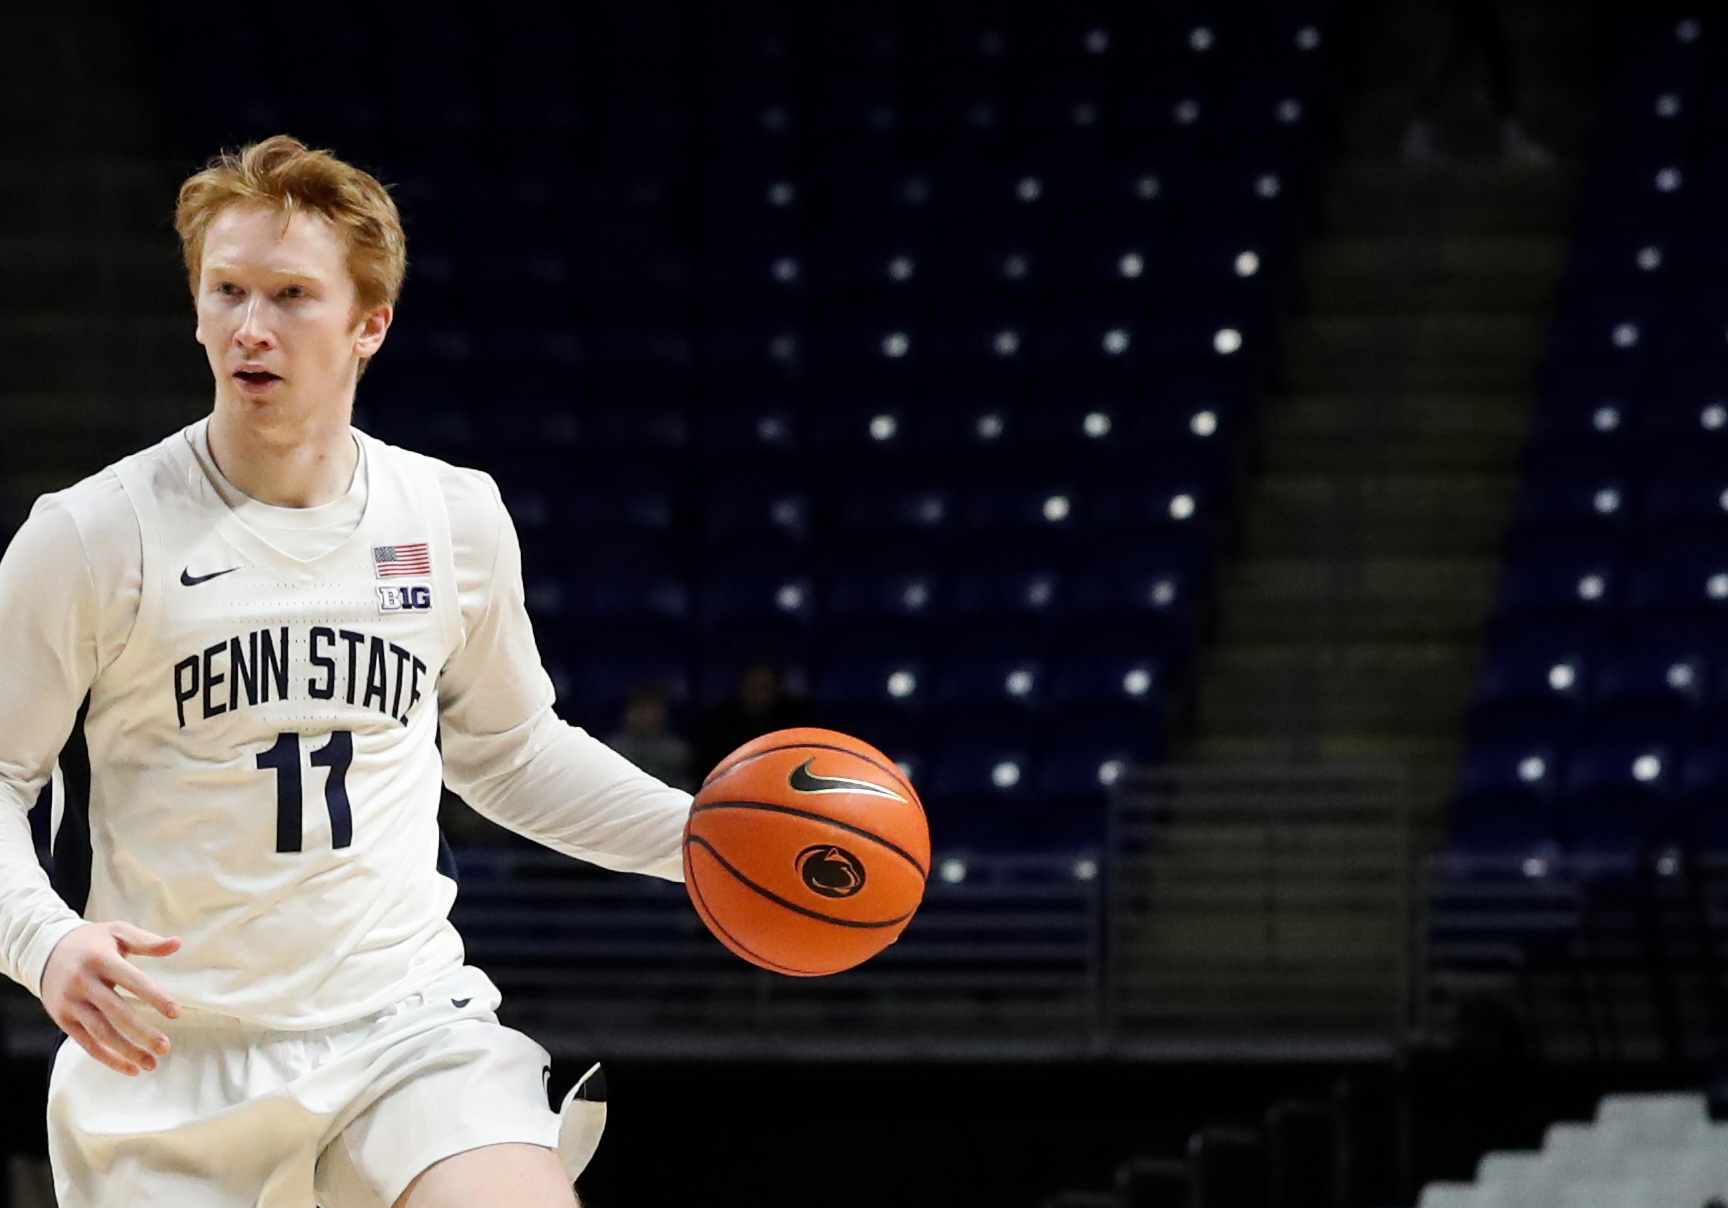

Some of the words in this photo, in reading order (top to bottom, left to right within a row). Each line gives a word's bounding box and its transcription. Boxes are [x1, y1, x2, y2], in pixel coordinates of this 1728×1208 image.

[174, 626, 289, 729] PENN
[308, 626, 427, 727] STATE
[256, 730, 354, 853] 11
